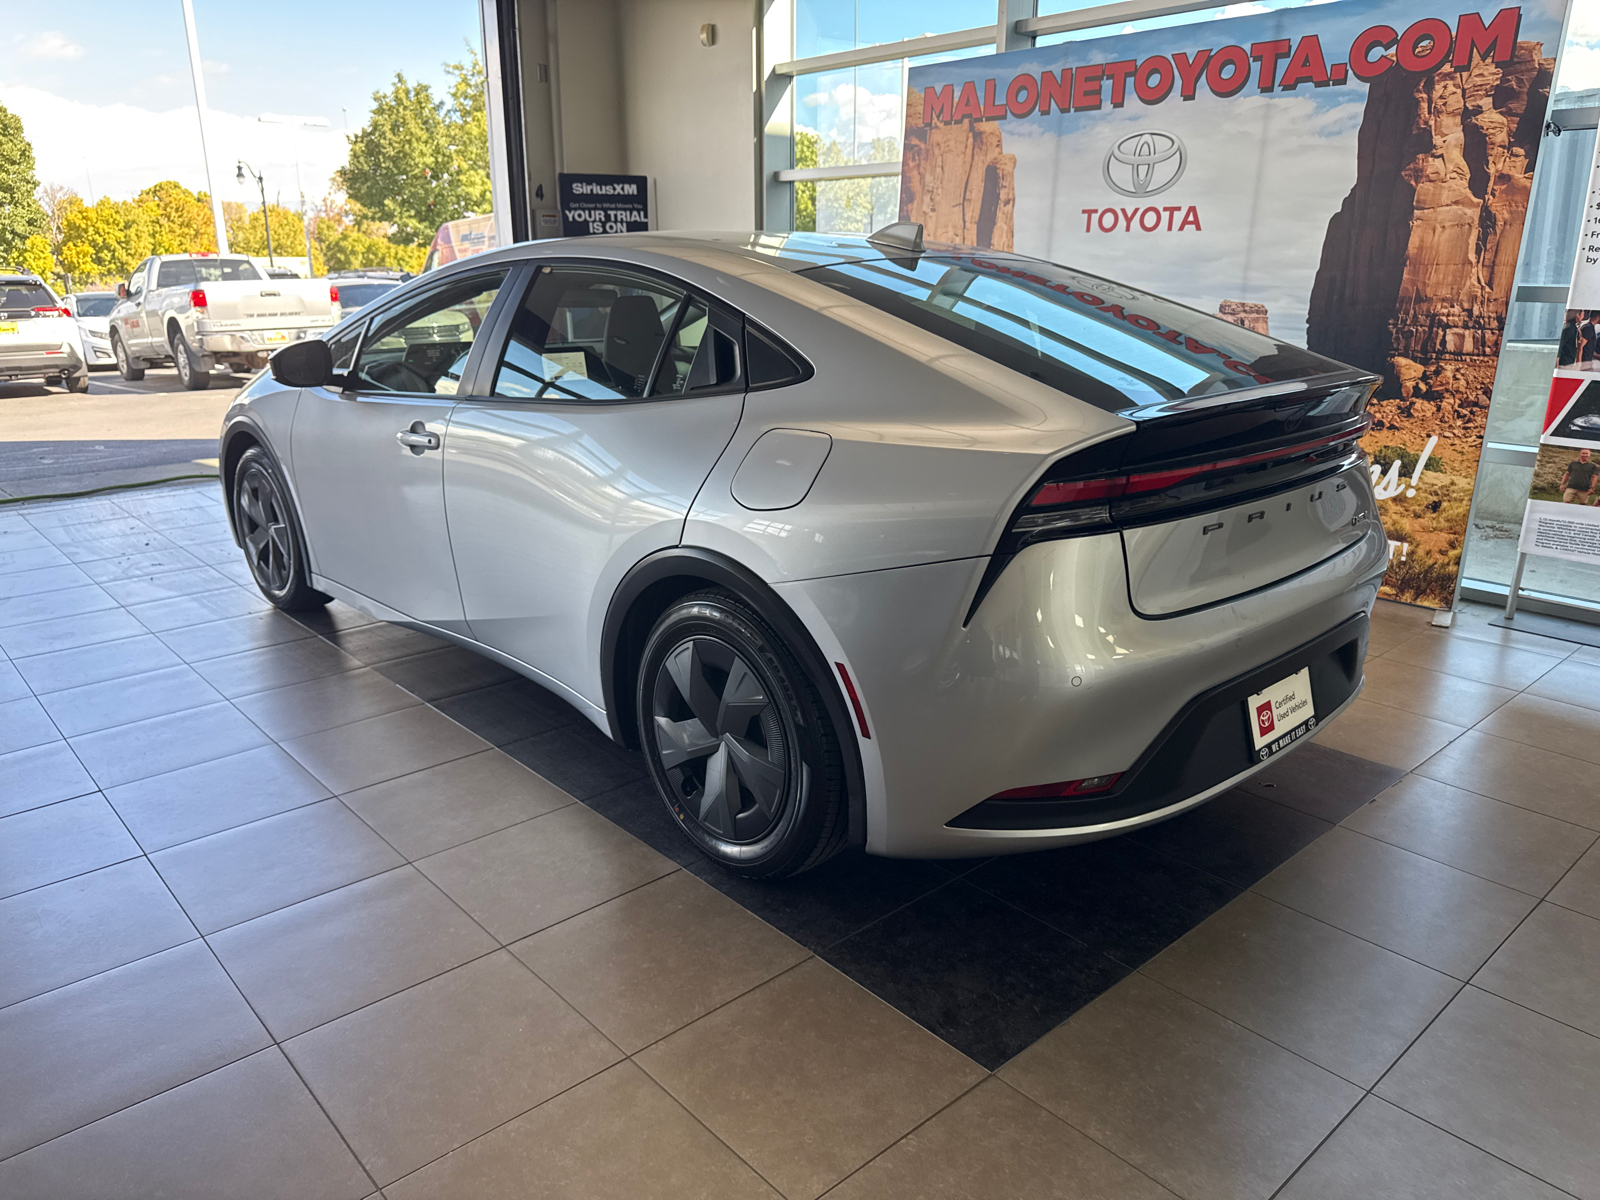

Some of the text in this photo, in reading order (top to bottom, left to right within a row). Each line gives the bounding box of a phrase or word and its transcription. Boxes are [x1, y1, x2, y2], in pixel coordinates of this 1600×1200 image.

[922, 6, 1521, 126] MALONETOYOTA.COM
[535, 184, 544, 200] 4
[572, 182, 637, 195] SiriusXM
[565, 210, 605, 222] YOUR
[607, 210, 648, 222] TRIAL
[1081, 206, 1202, 233] TOYOTA
[589, 222, 628, 233] IS ON
[1586, 255, 1599, 265] by
[1203, 481, 1347, 535] PRIUS
[1275, 691, 1295, 709] Certified
[1277, 699, 1308, 722] Used Vehicles
[1271, 724, 1306, 752] WE MAKE IT EASY
